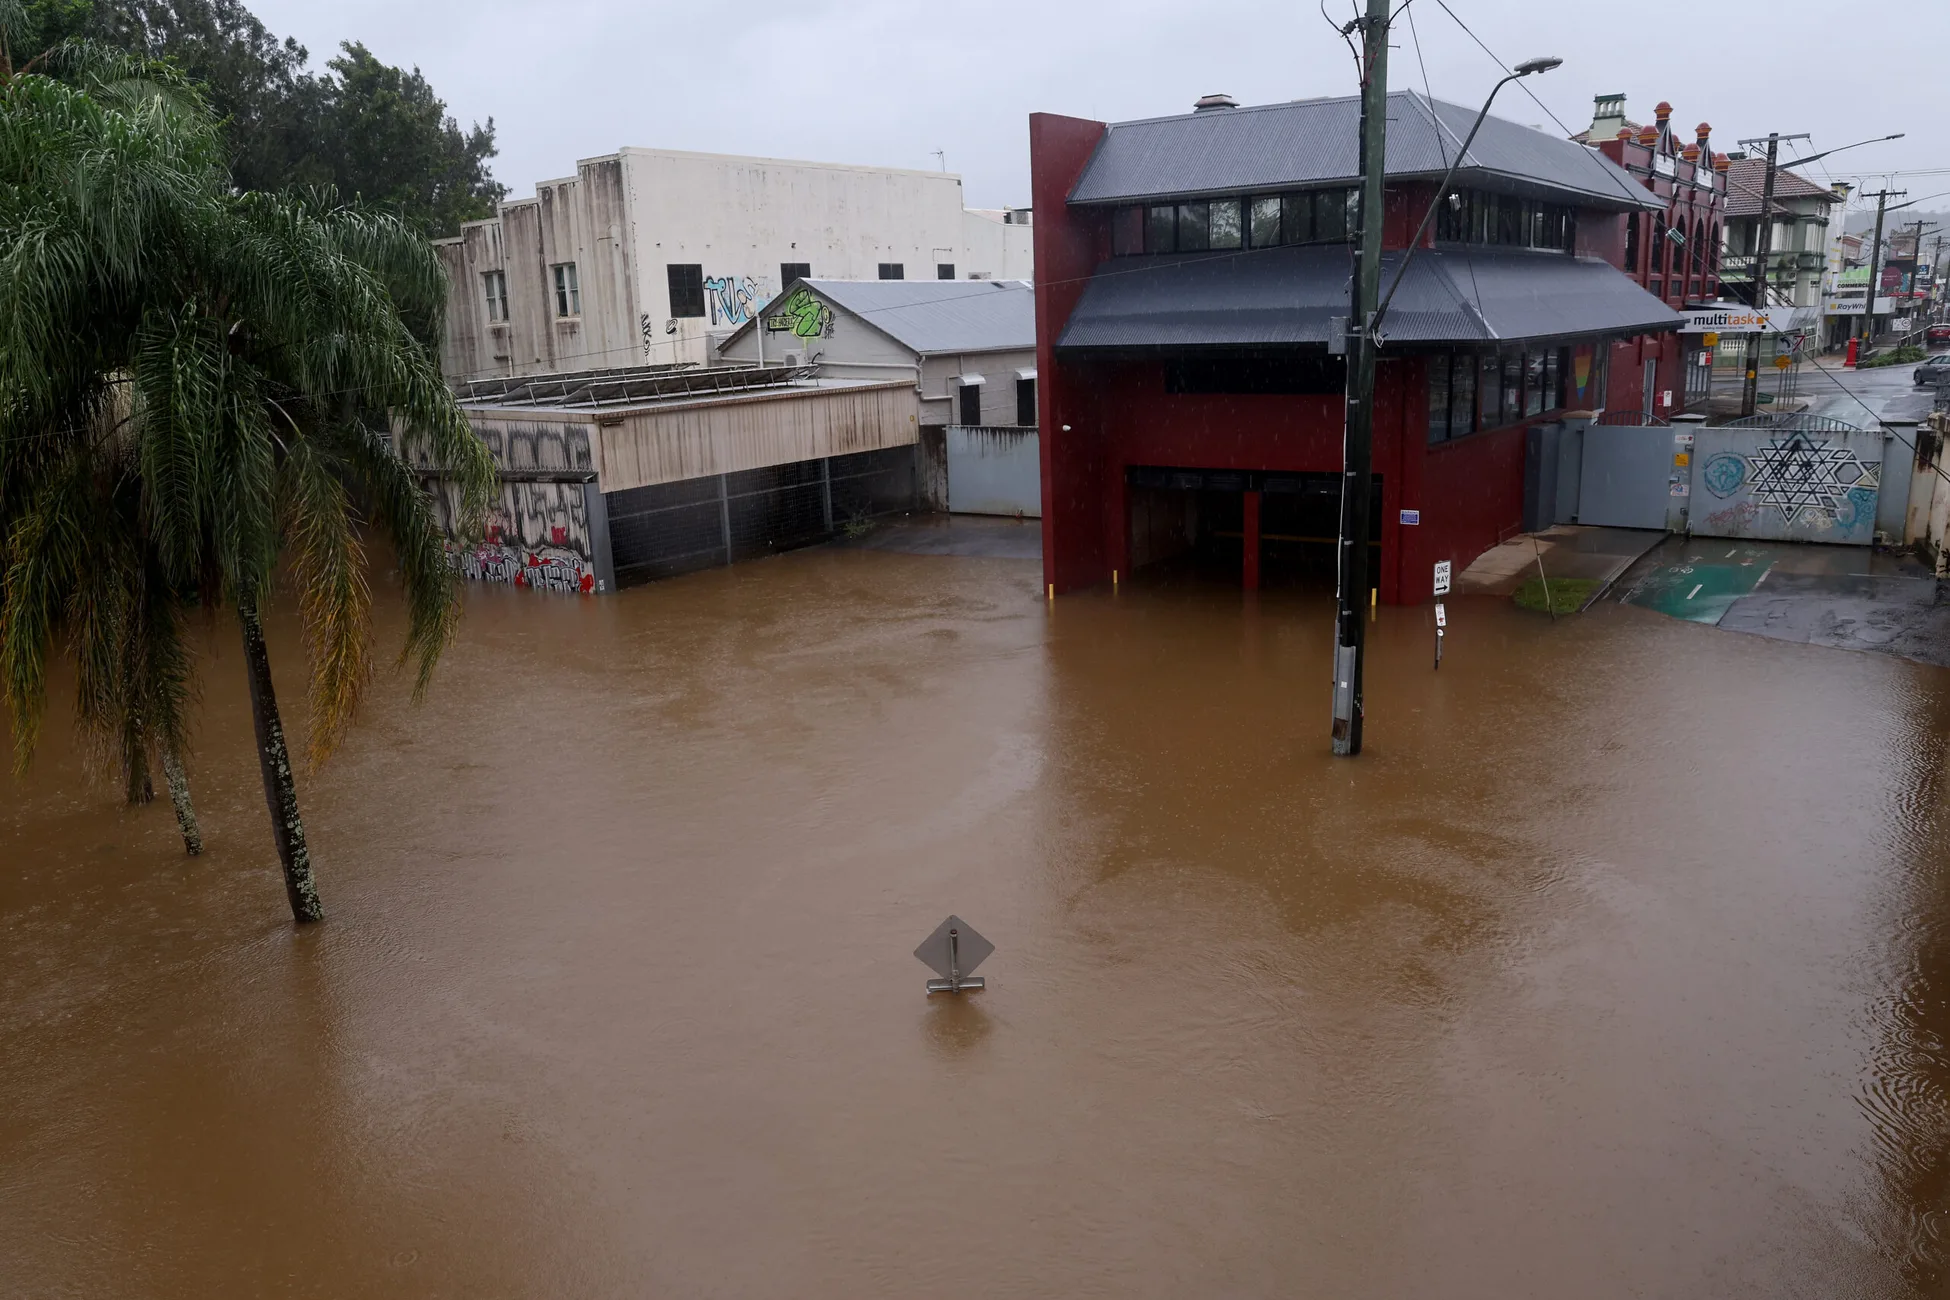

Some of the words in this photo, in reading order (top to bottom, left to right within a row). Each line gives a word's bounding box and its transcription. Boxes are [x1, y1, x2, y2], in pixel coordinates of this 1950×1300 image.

[1694, 313, 1755, 325] multitask
[1436, 565, 1448, 574] ONE
[1436, 575, 1449, 584] WAY
